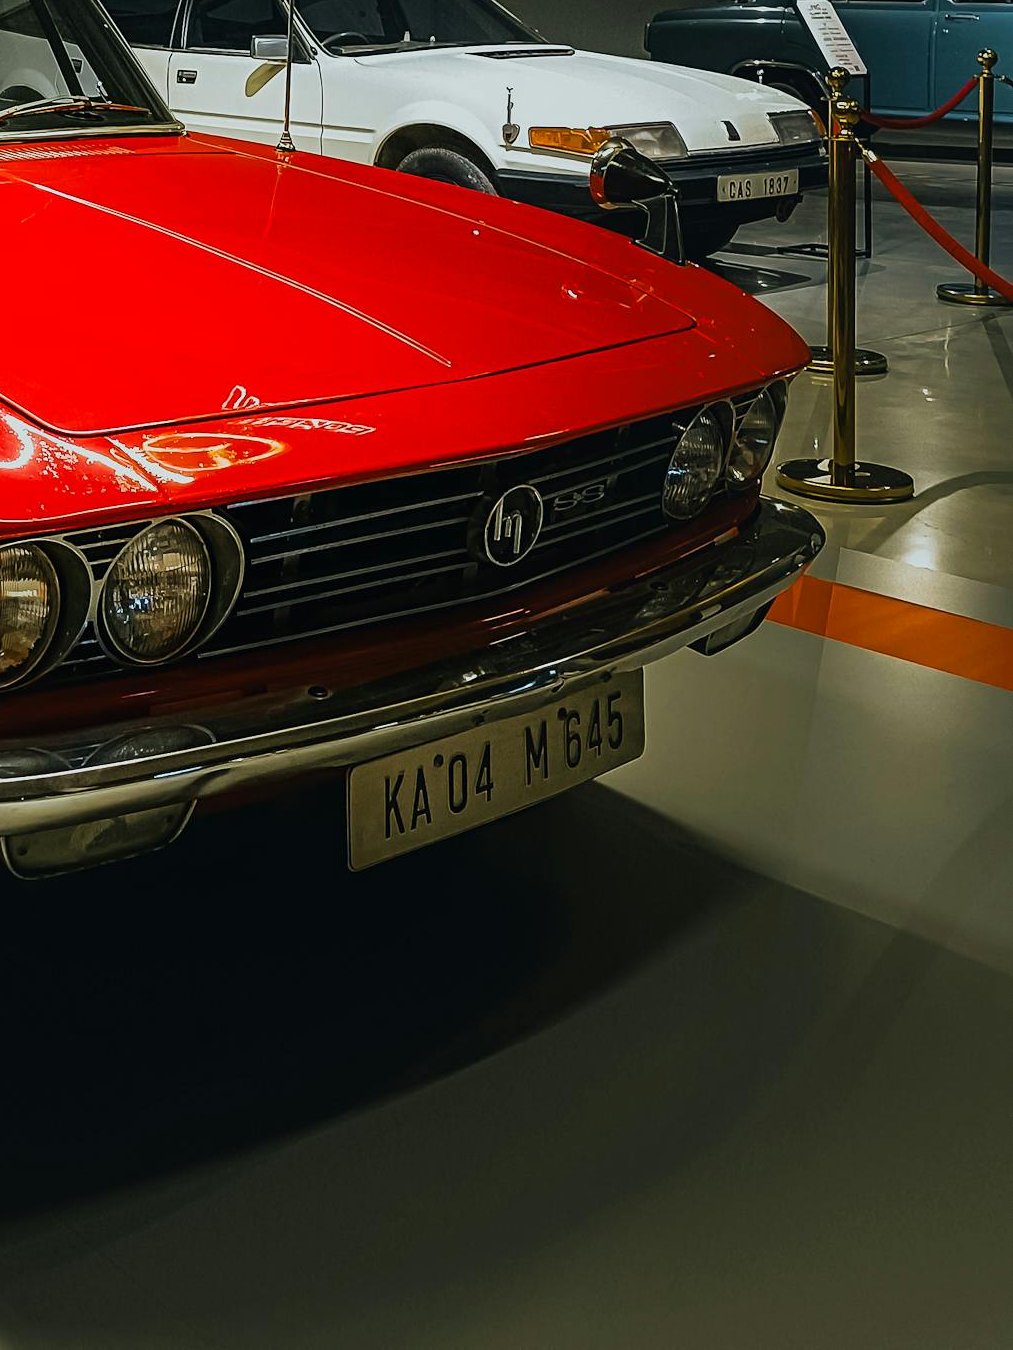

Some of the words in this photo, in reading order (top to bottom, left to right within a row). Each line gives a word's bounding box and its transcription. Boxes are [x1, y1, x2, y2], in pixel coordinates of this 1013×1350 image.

[763, 176, 789, 195] 1837
[384, 764, 432, 839] KA
[448, 742, 494, 815] 04
[524, 720, 549, 786] M
[563, 690, 624, 769] 645
